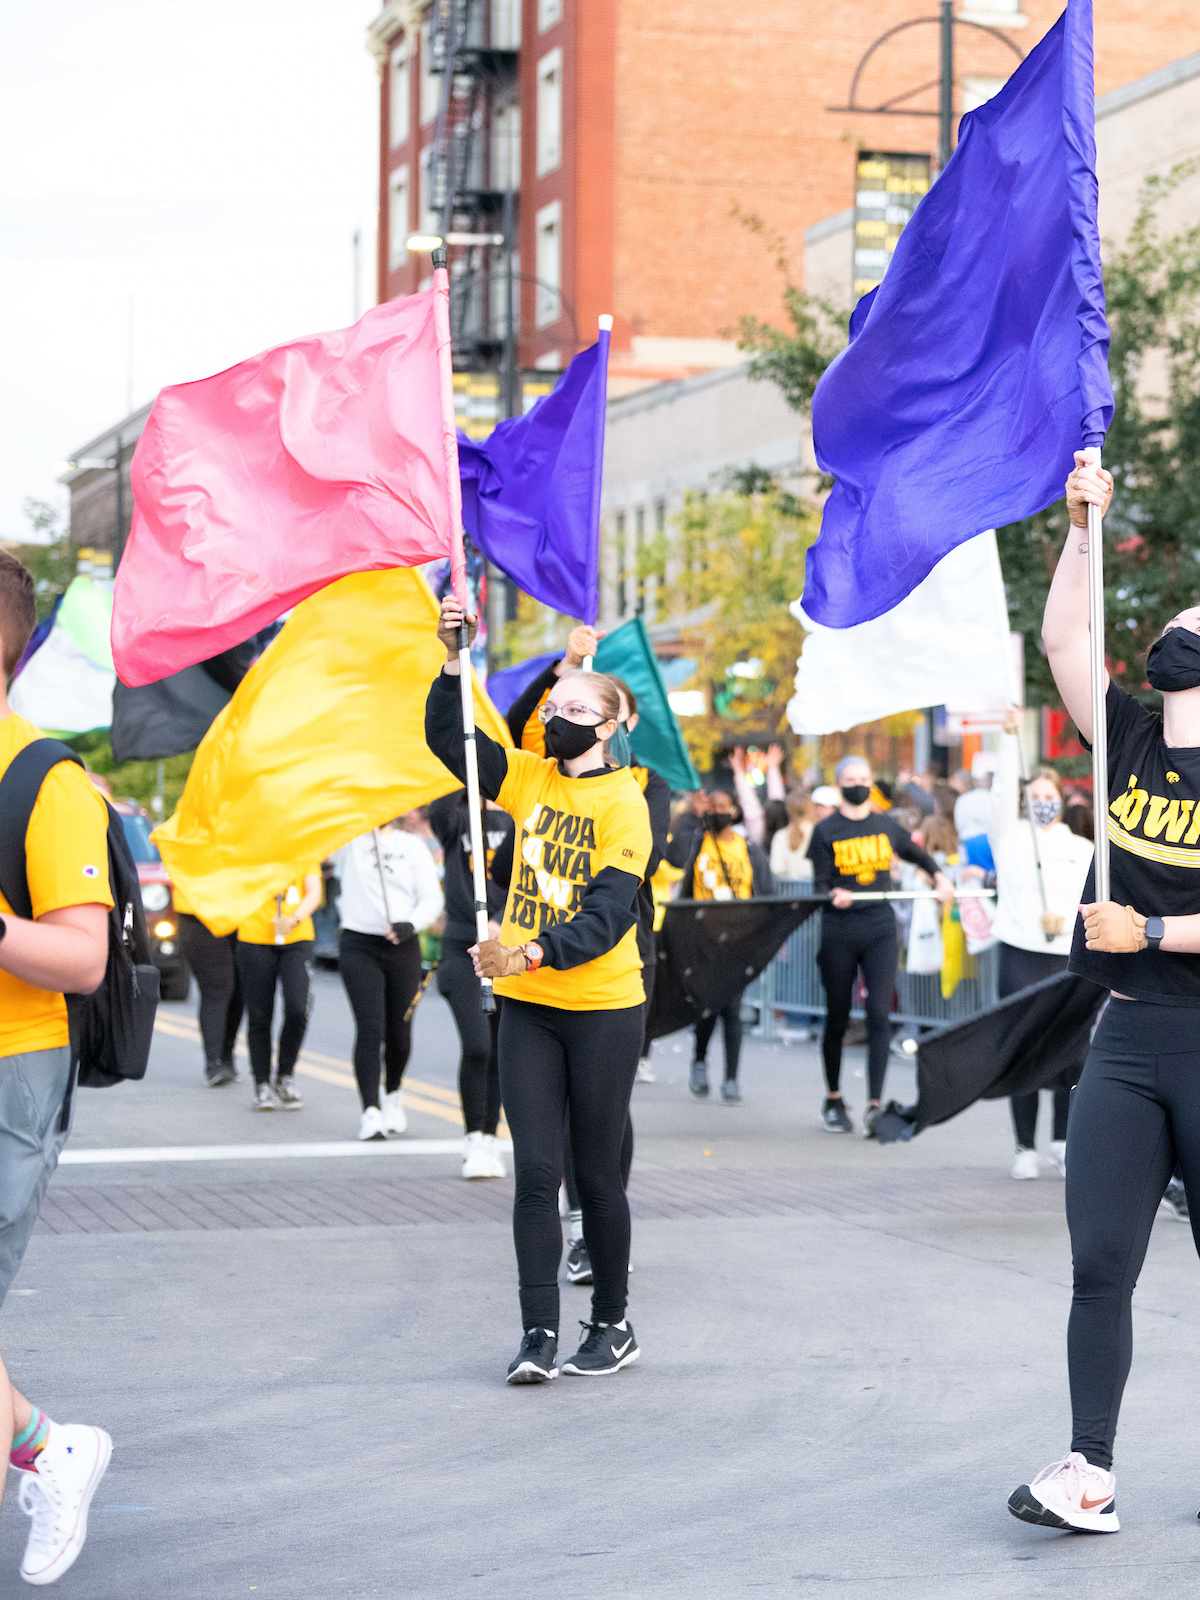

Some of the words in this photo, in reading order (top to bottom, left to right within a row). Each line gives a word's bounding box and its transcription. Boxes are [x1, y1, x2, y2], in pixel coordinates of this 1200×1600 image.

[524, 802, 596, 850] IOWA
[832, 832, 893, 868] IOWA
[509, 893, 578, 938] IOW
